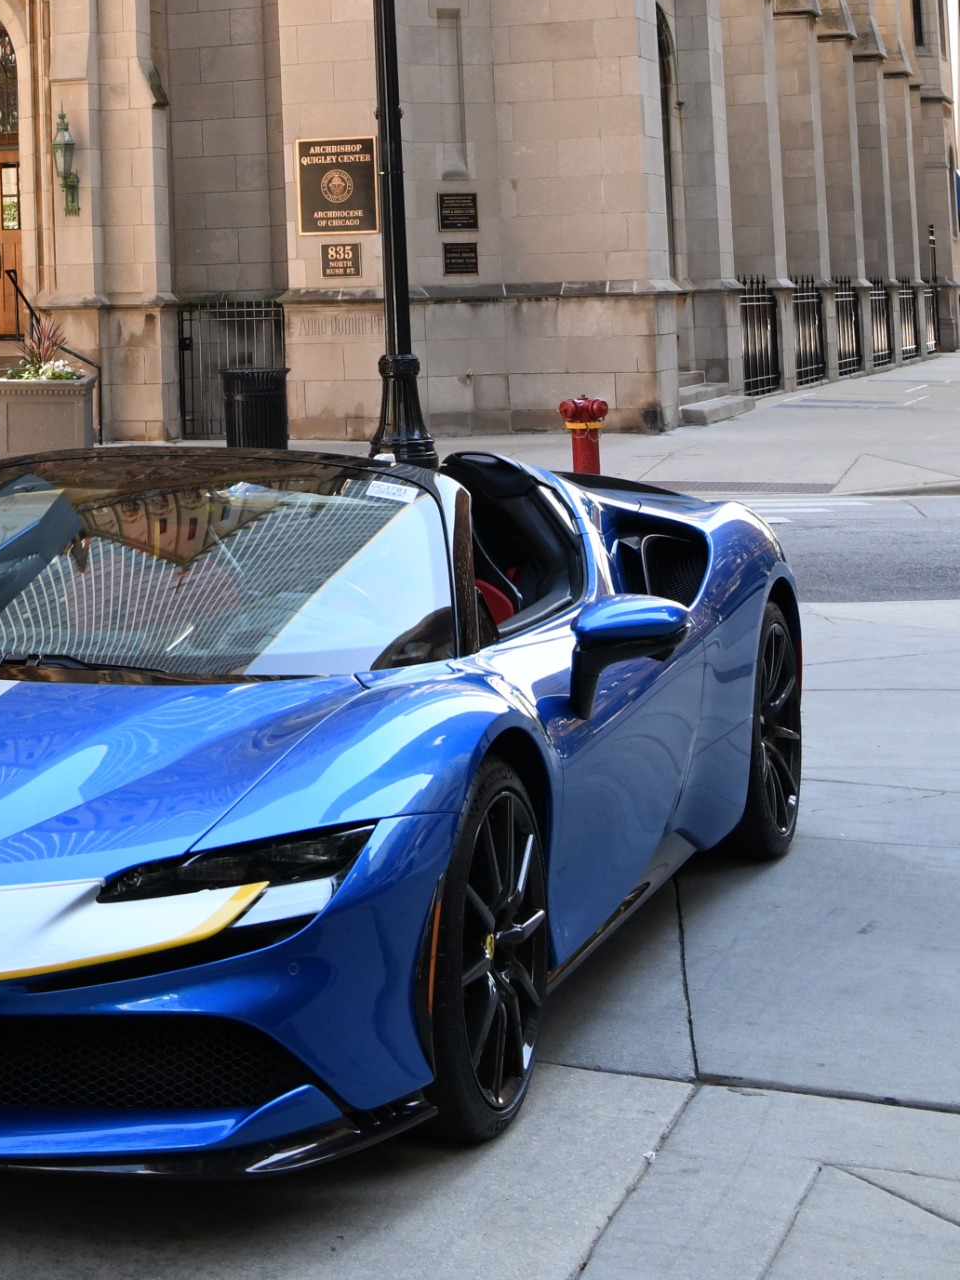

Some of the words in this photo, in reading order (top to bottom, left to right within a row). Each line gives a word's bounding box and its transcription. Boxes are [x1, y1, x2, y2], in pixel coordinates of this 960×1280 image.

[309, 144, 362, 154] ARCHBISHOP
[301, 155, 337, 166] QUIGLEY
[338, 154, 371, 162] CENTER
[313, 210, 363, 218] ARCHDIOCESE
[328, 246, 353, 260] 835
